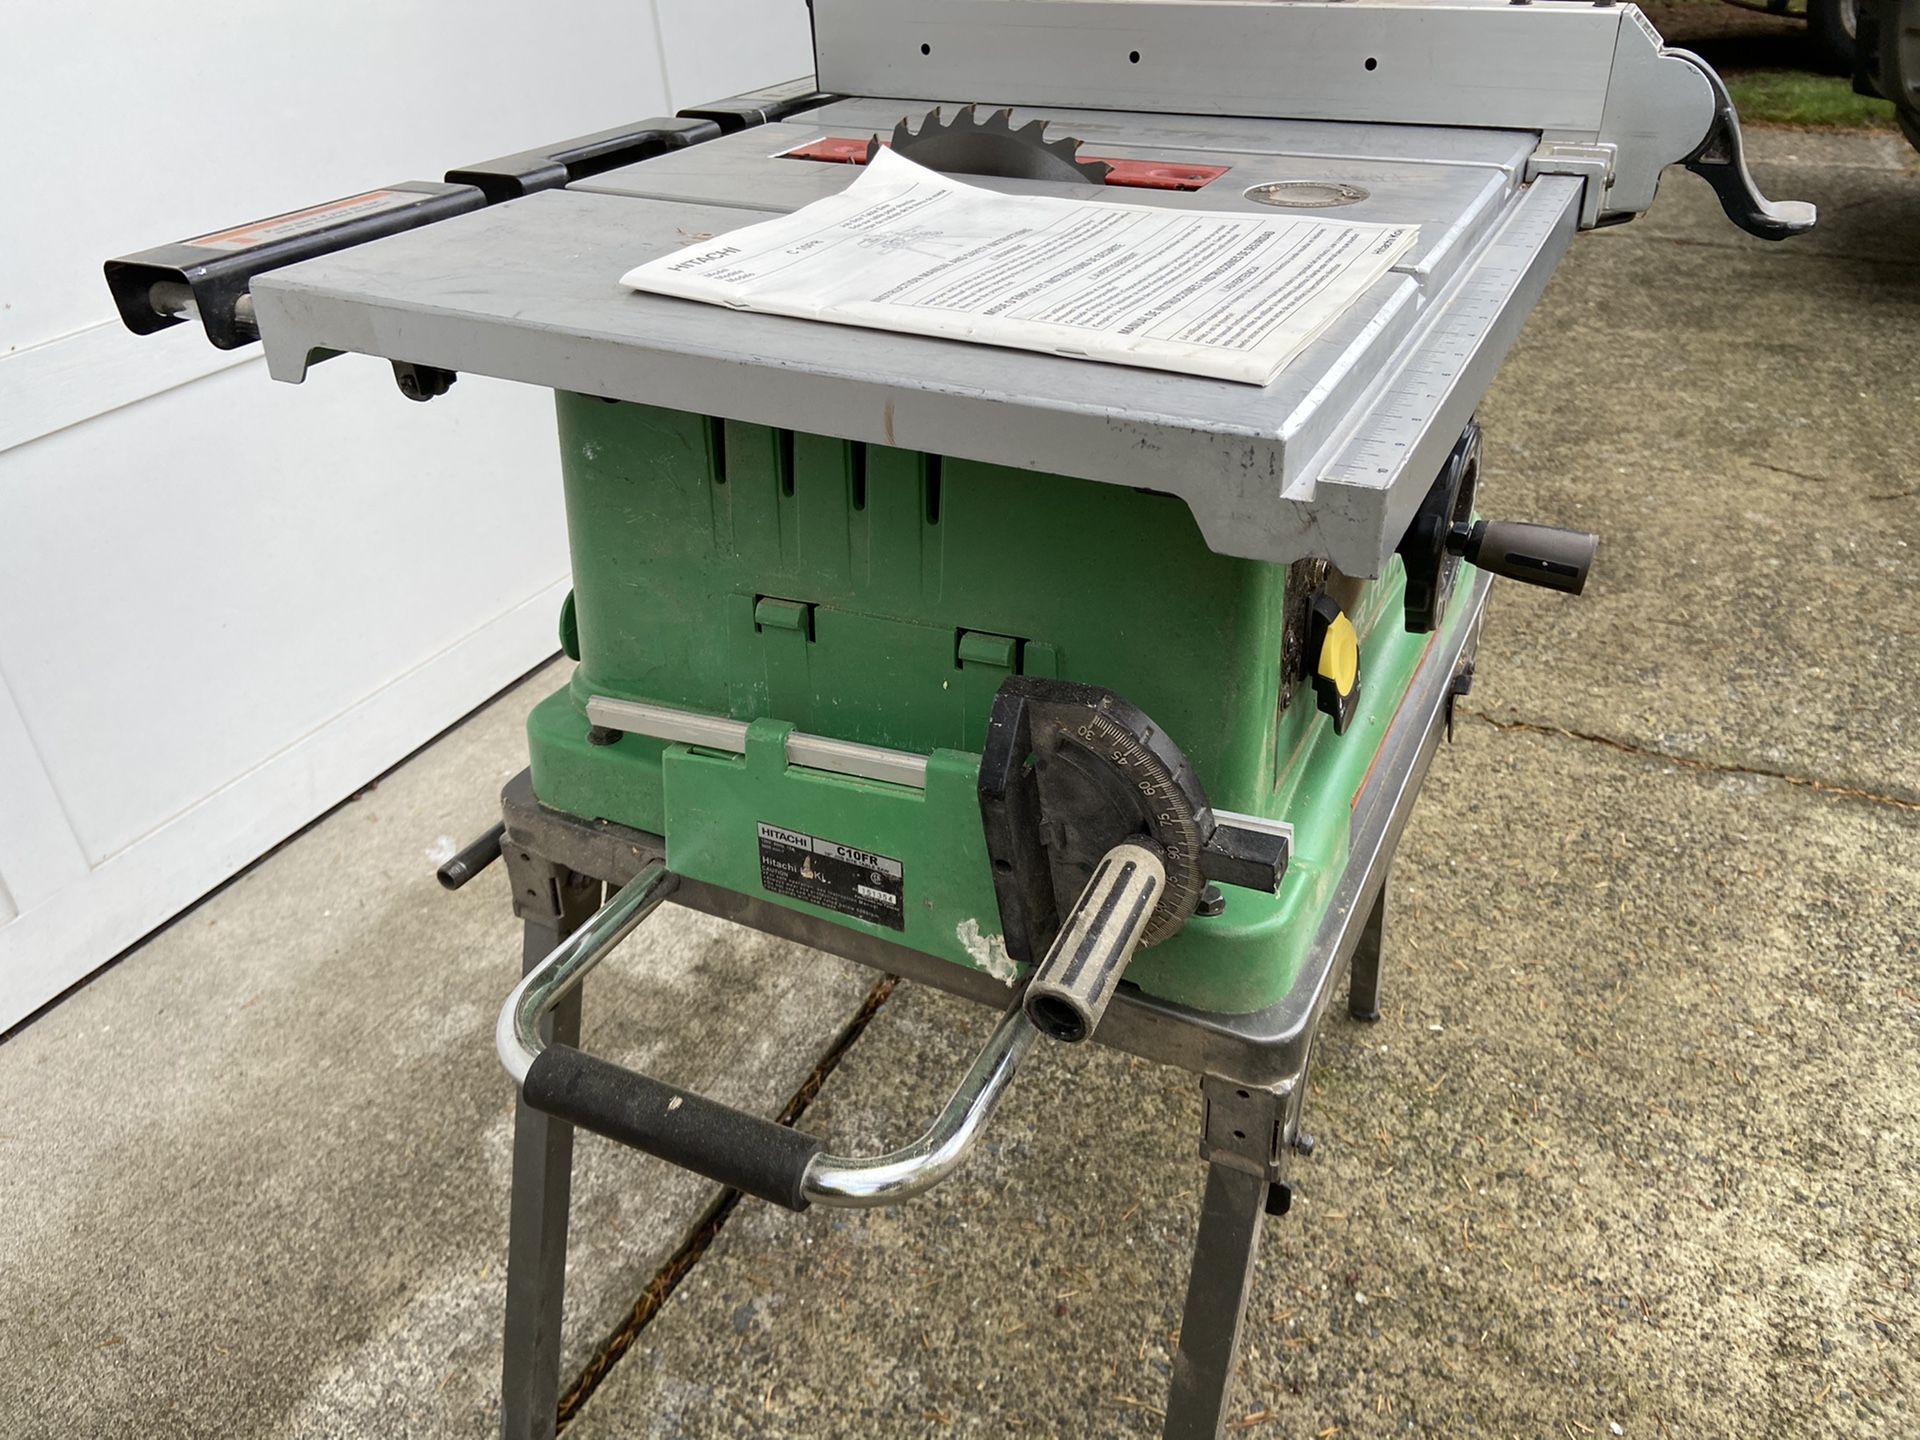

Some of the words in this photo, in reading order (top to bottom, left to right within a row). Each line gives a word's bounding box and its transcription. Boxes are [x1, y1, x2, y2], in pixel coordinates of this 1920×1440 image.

[667, 246, 742, 272] HITACHI
[1118, 315, 1154, 334] MANUAL
[1078, 726, 1095, 740] 30
[1111, 751, 1128, 764] 45
[1138, 781, 1156, 796] 60
[1157, 813, 1173, 827] 75
[762, 827, 807, 847] HITACHI
[836, 846, 878, 866] C10FR
[1166, 846, 1180, 860] 90
[762, 856, 797, 873] Hitachi
